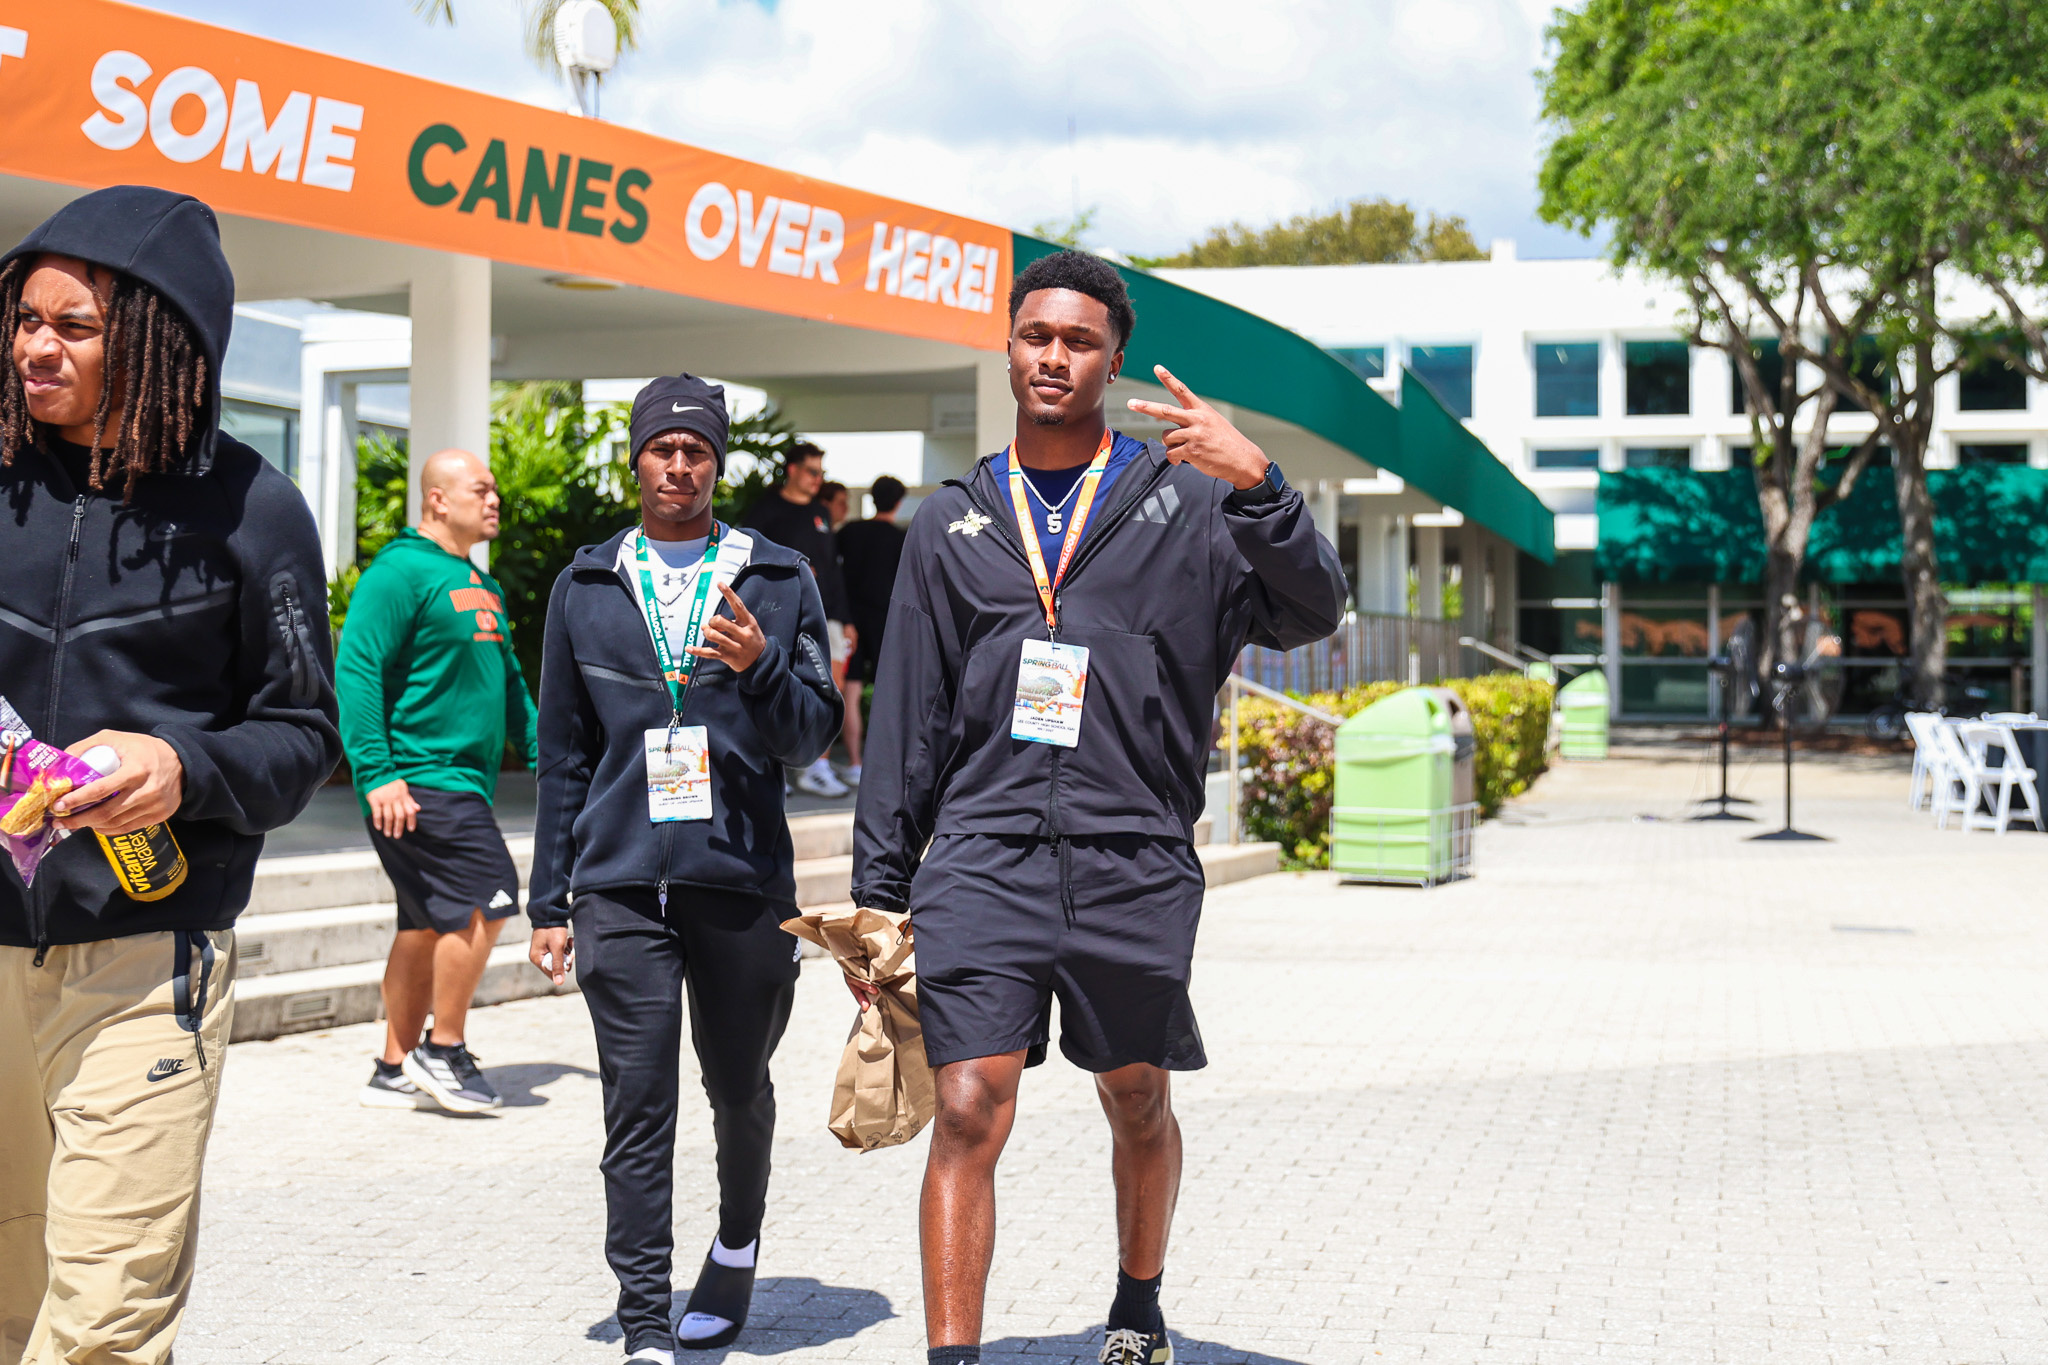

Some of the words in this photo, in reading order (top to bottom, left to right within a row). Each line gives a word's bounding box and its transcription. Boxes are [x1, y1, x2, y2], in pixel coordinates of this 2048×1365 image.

[81, 50, 364, 192] SOME
[407, 123, 653, 244] CANES
[684, 181, 845, 285] OVER
[864, 221, 999, 314] HERE!
[1046, 513, 1062, 534] 5
[1071, 504, 1087, 532] MIAMI
[1057, 532, 1077, 577] FOOTBALL
[647, 597, 663, 640] FOOTBALL
[657, 640, 671, 666] MIAMI
[682, 624, 698, 668] FOOTALL
[1022, 658, 1051, 668] SPRING
[28, 747, 53, 770] SWEET
[40, 751, 59, 769] CHILI
[113, 836, 151, 892] vitamin
[128, 831, 158, 872] water
[154, 1058, 184, 1072] NIKE
